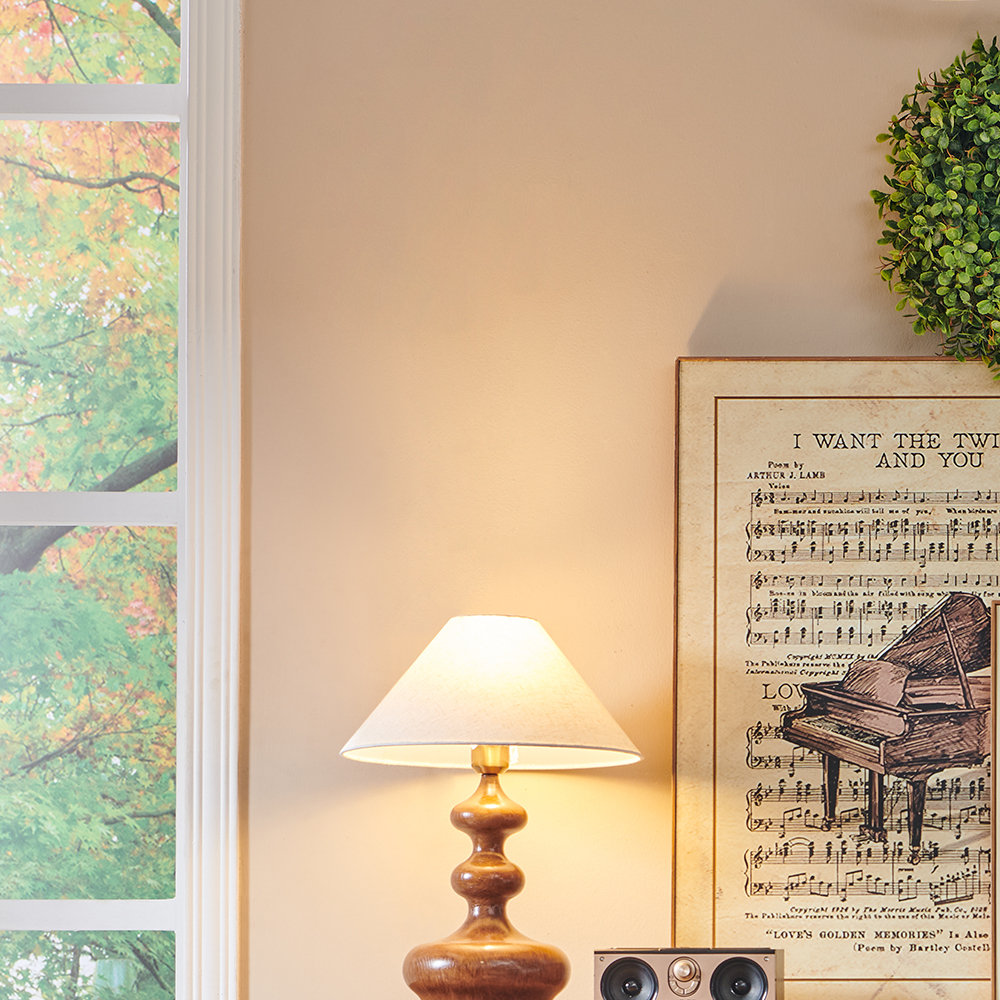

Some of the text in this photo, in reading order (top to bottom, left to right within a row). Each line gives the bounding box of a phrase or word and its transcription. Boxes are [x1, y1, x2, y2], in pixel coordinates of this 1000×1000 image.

[793, 434, 801, 449] I
[813, 433, 881, 449] WANT
[894, 433, 941, 449] THE
[794, 461, 804, 470] by
[876, 452, 984, 468] AND YOU
[819, 931, 865, 939] GOLDEN
[965, 931, 989, 939] Also
[854, 943, 884, 951] (Poem
[890, 944, 902, 954] by
[909, 944, 949, 953] Bartley
